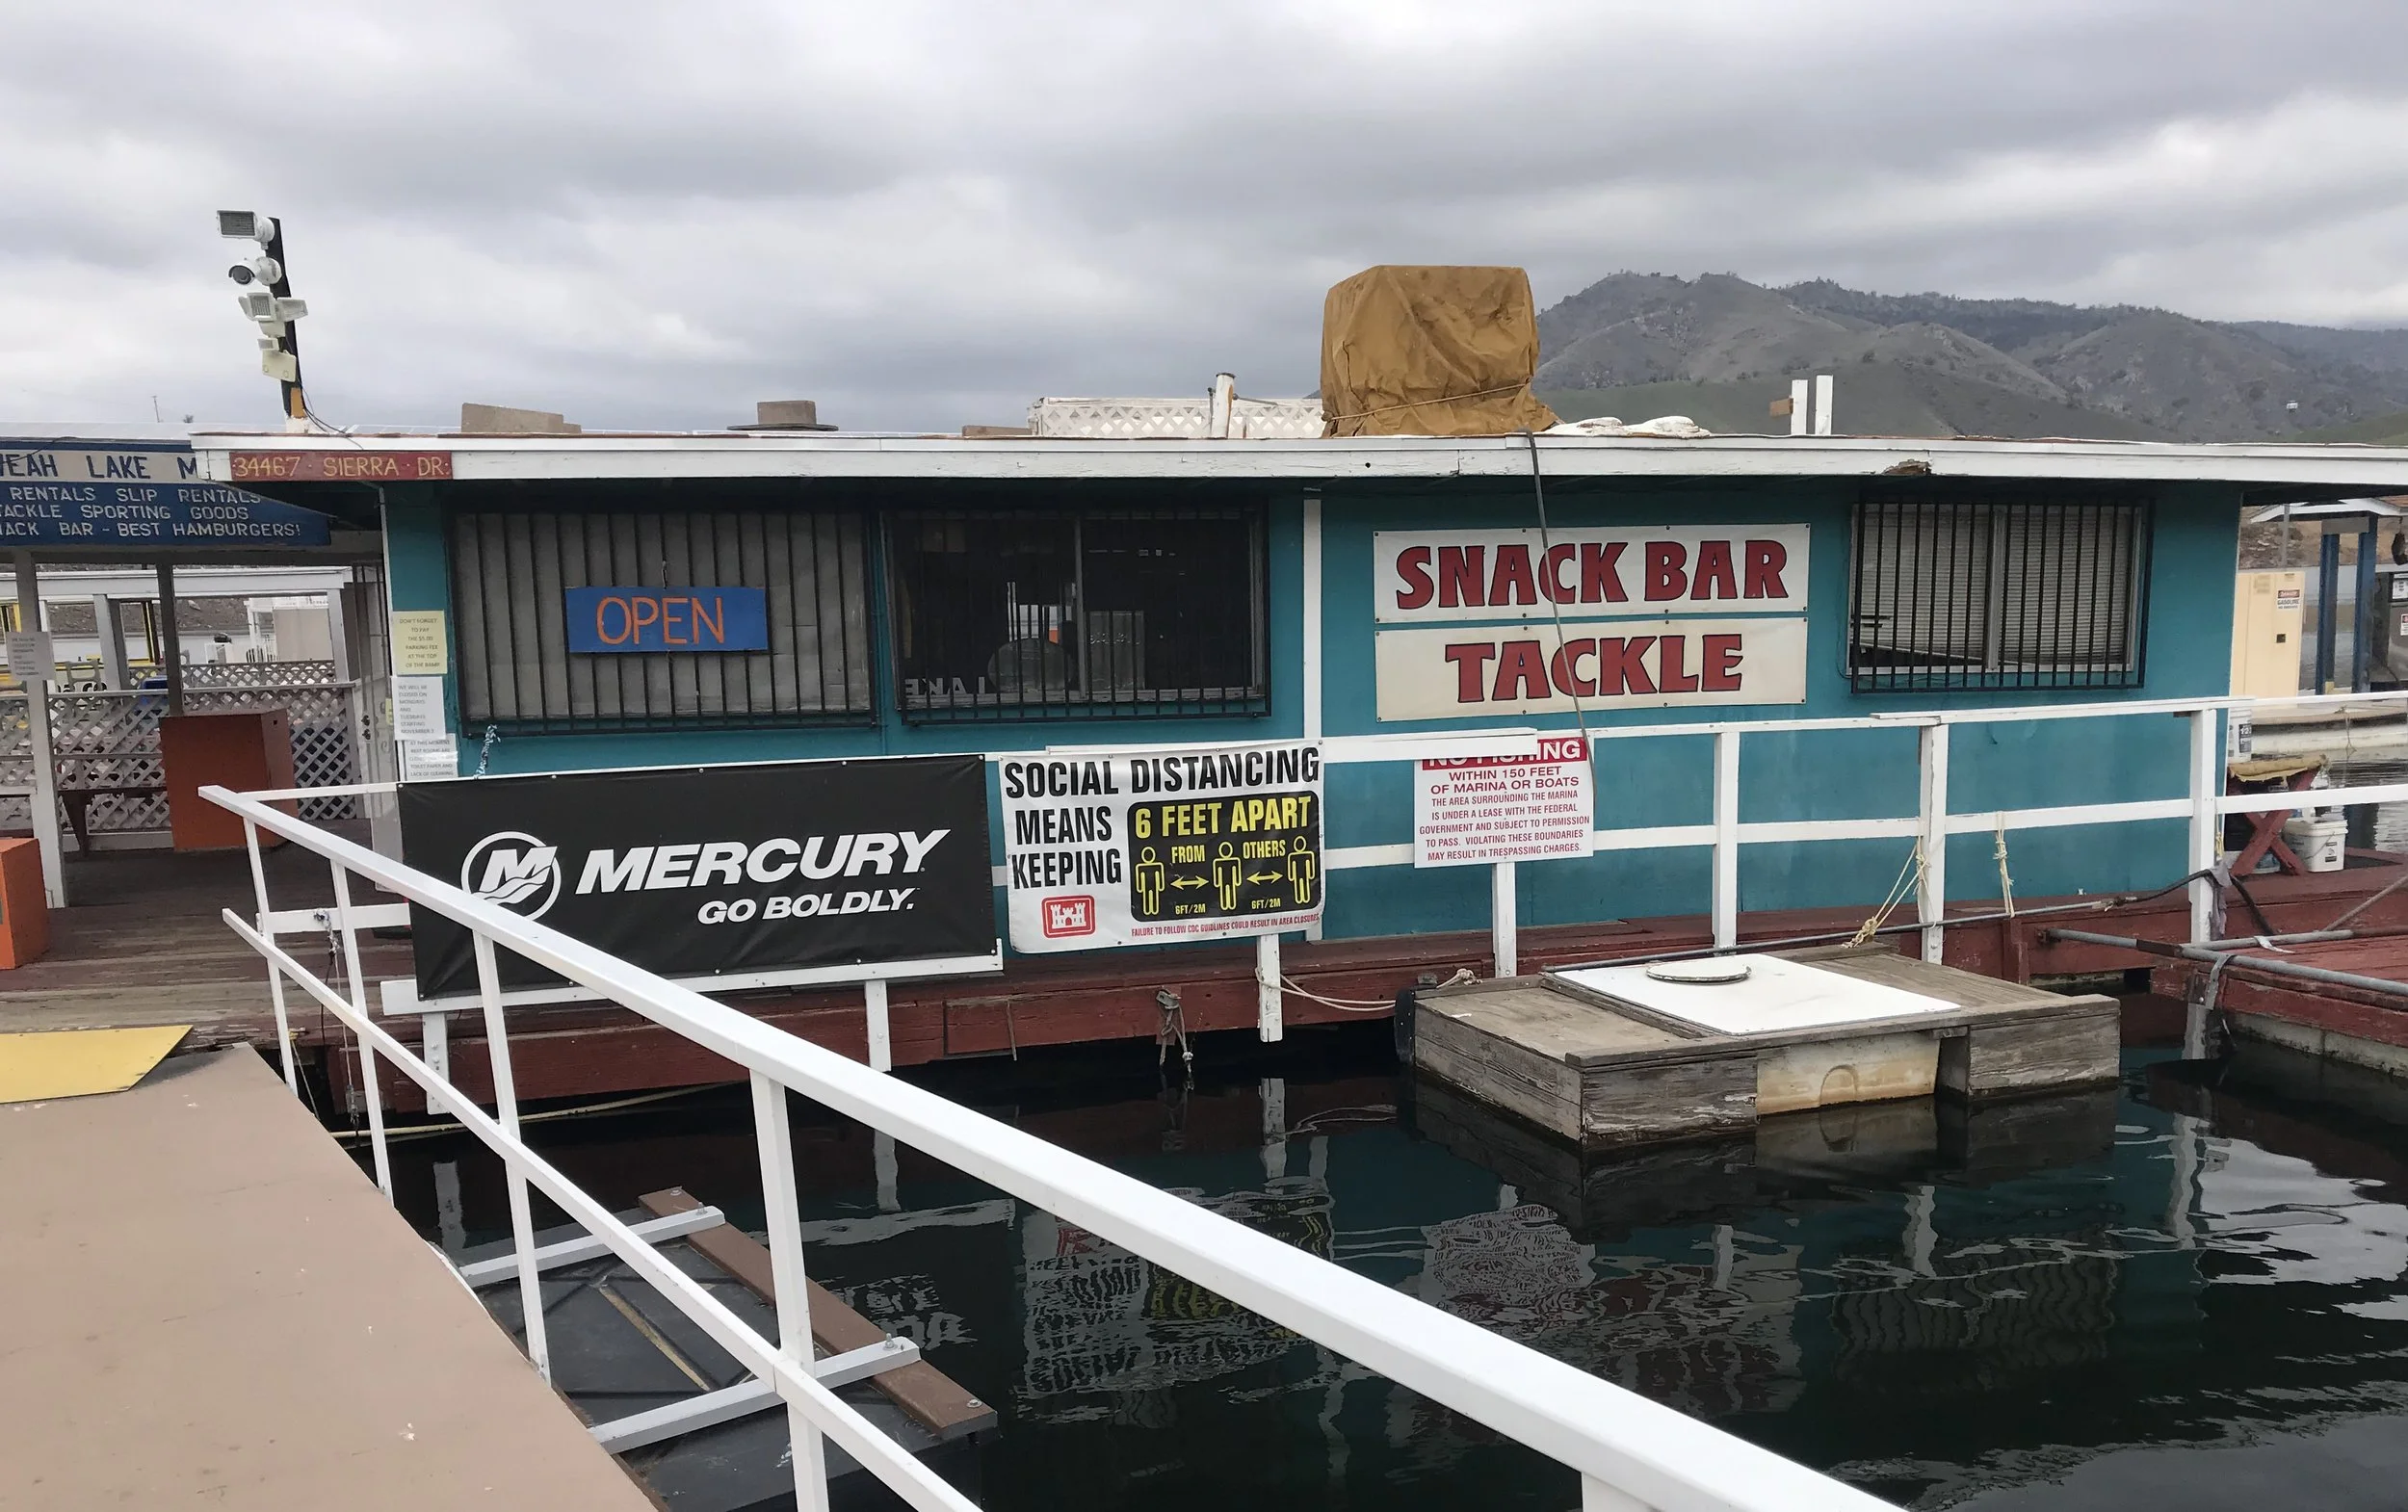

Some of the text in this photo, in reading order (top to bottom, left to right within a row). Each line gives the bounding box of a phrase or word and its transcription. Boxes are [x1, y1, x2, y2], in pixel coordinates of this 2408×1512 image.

[0, 453, 59, 478] EAH
[86, 456, 151, 480] LAKE
[234, 456, 301, 477] 34467
[323, 456, 400, 477] SIERRA
[10, 486, 261, 504] RENTALS SLIP RENTALS
[80, 505, 171, 519] SPORTING
[191, 506, 249, 520] GOODS
[0, 522, 39, 536] ACK
[59, 522, 93, 536] BAR
[117, 522, 161, 536] BEST
[171, 523, 301, 537] HAMBURGERS!
[1396, 539, 1790, 609] SNACK BAR
[595, 596, 724, 645] OPEN
[1445, 633, 1743, 703] TACKLE
[1004, 746, 1320, 798] SOCIAL DISTANCING
[1449, 766, 1562, 781] WITHIN 150 FEET
[1431, 777, 1579, 794] OF MARINA OR BOATS
[1432, 790, 1578, 807] THE AREA SURROUNDING THE MARINA
[1135, 795, 1312, 839] 6 FEET APART
[1432, 803, 1578, 820] IS UNDER A LEASE WITH THE FEDERAL
[1014, 805, 1112, 846] MEANS
[1420, 816, 1590, 835] GOVERNMENT AND SUBJECT TO PERMISSION
[1426, 829, 1583, 847] TO PASS. VIOLATING THESE BOUNDARIES
[1171, 839, 1286, 864] FROM OTHERS
[1428, 843, 1582, 861] MAY RESULT IN TRESPASSING CHARGES.
[576, 829, 952, 895] MERCURY
[1011, 848, 1122, 889] KEEPING
[697, 887, 916, 925] GO BOLDLY.
[1175, 903, 1206, 915] 6FT/2M
[1251, 898, 1281, 910] 6FT/2M
[1131, 927, 1154, 937] FAILURE
[1164, 925, 1186, 934] FOLLOW
[1231, 921, 1249, 930] COULD
[1250, 920, 1270, 929] RESULT
[1279, 917, 1293, 926] AREA
